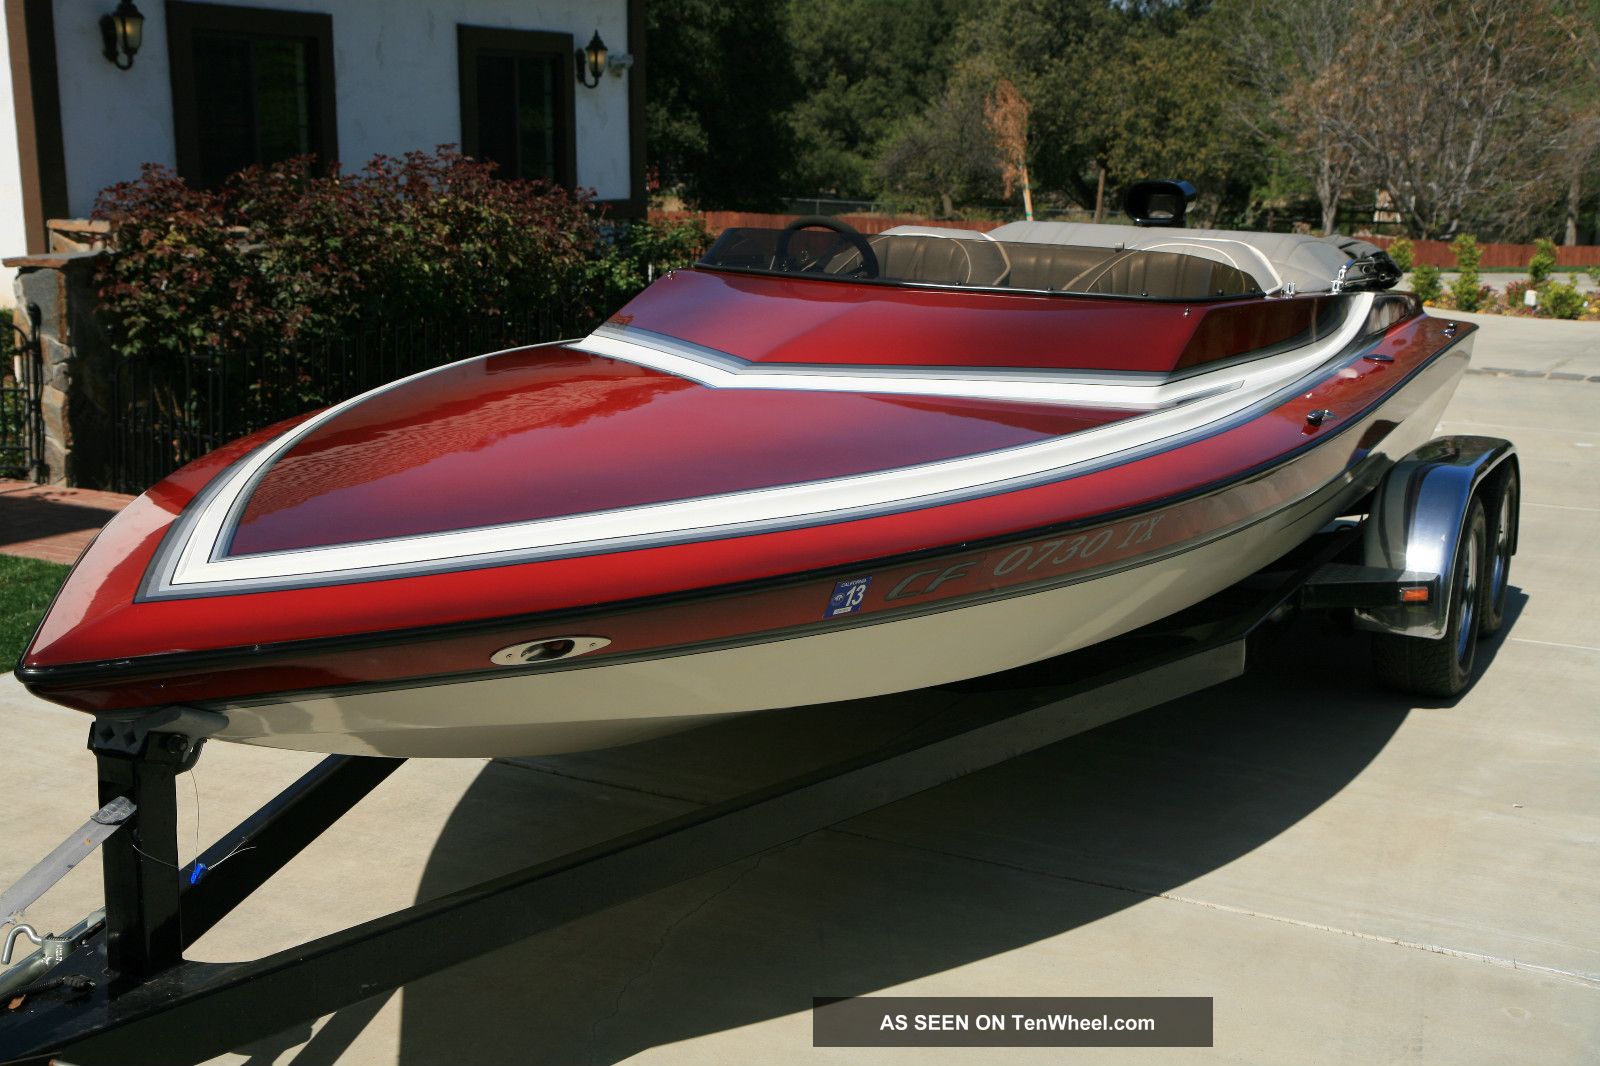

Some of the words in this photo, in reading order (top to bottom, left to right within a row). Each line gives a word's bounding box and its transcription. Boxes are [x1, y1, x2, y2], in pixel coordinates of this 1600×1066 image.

[886, 562, 975, 601] CF
[994, 530, 1113, 576] 0730
[1118, 513, 1166, 549] TX
[845, 584, 867, 606] 13
